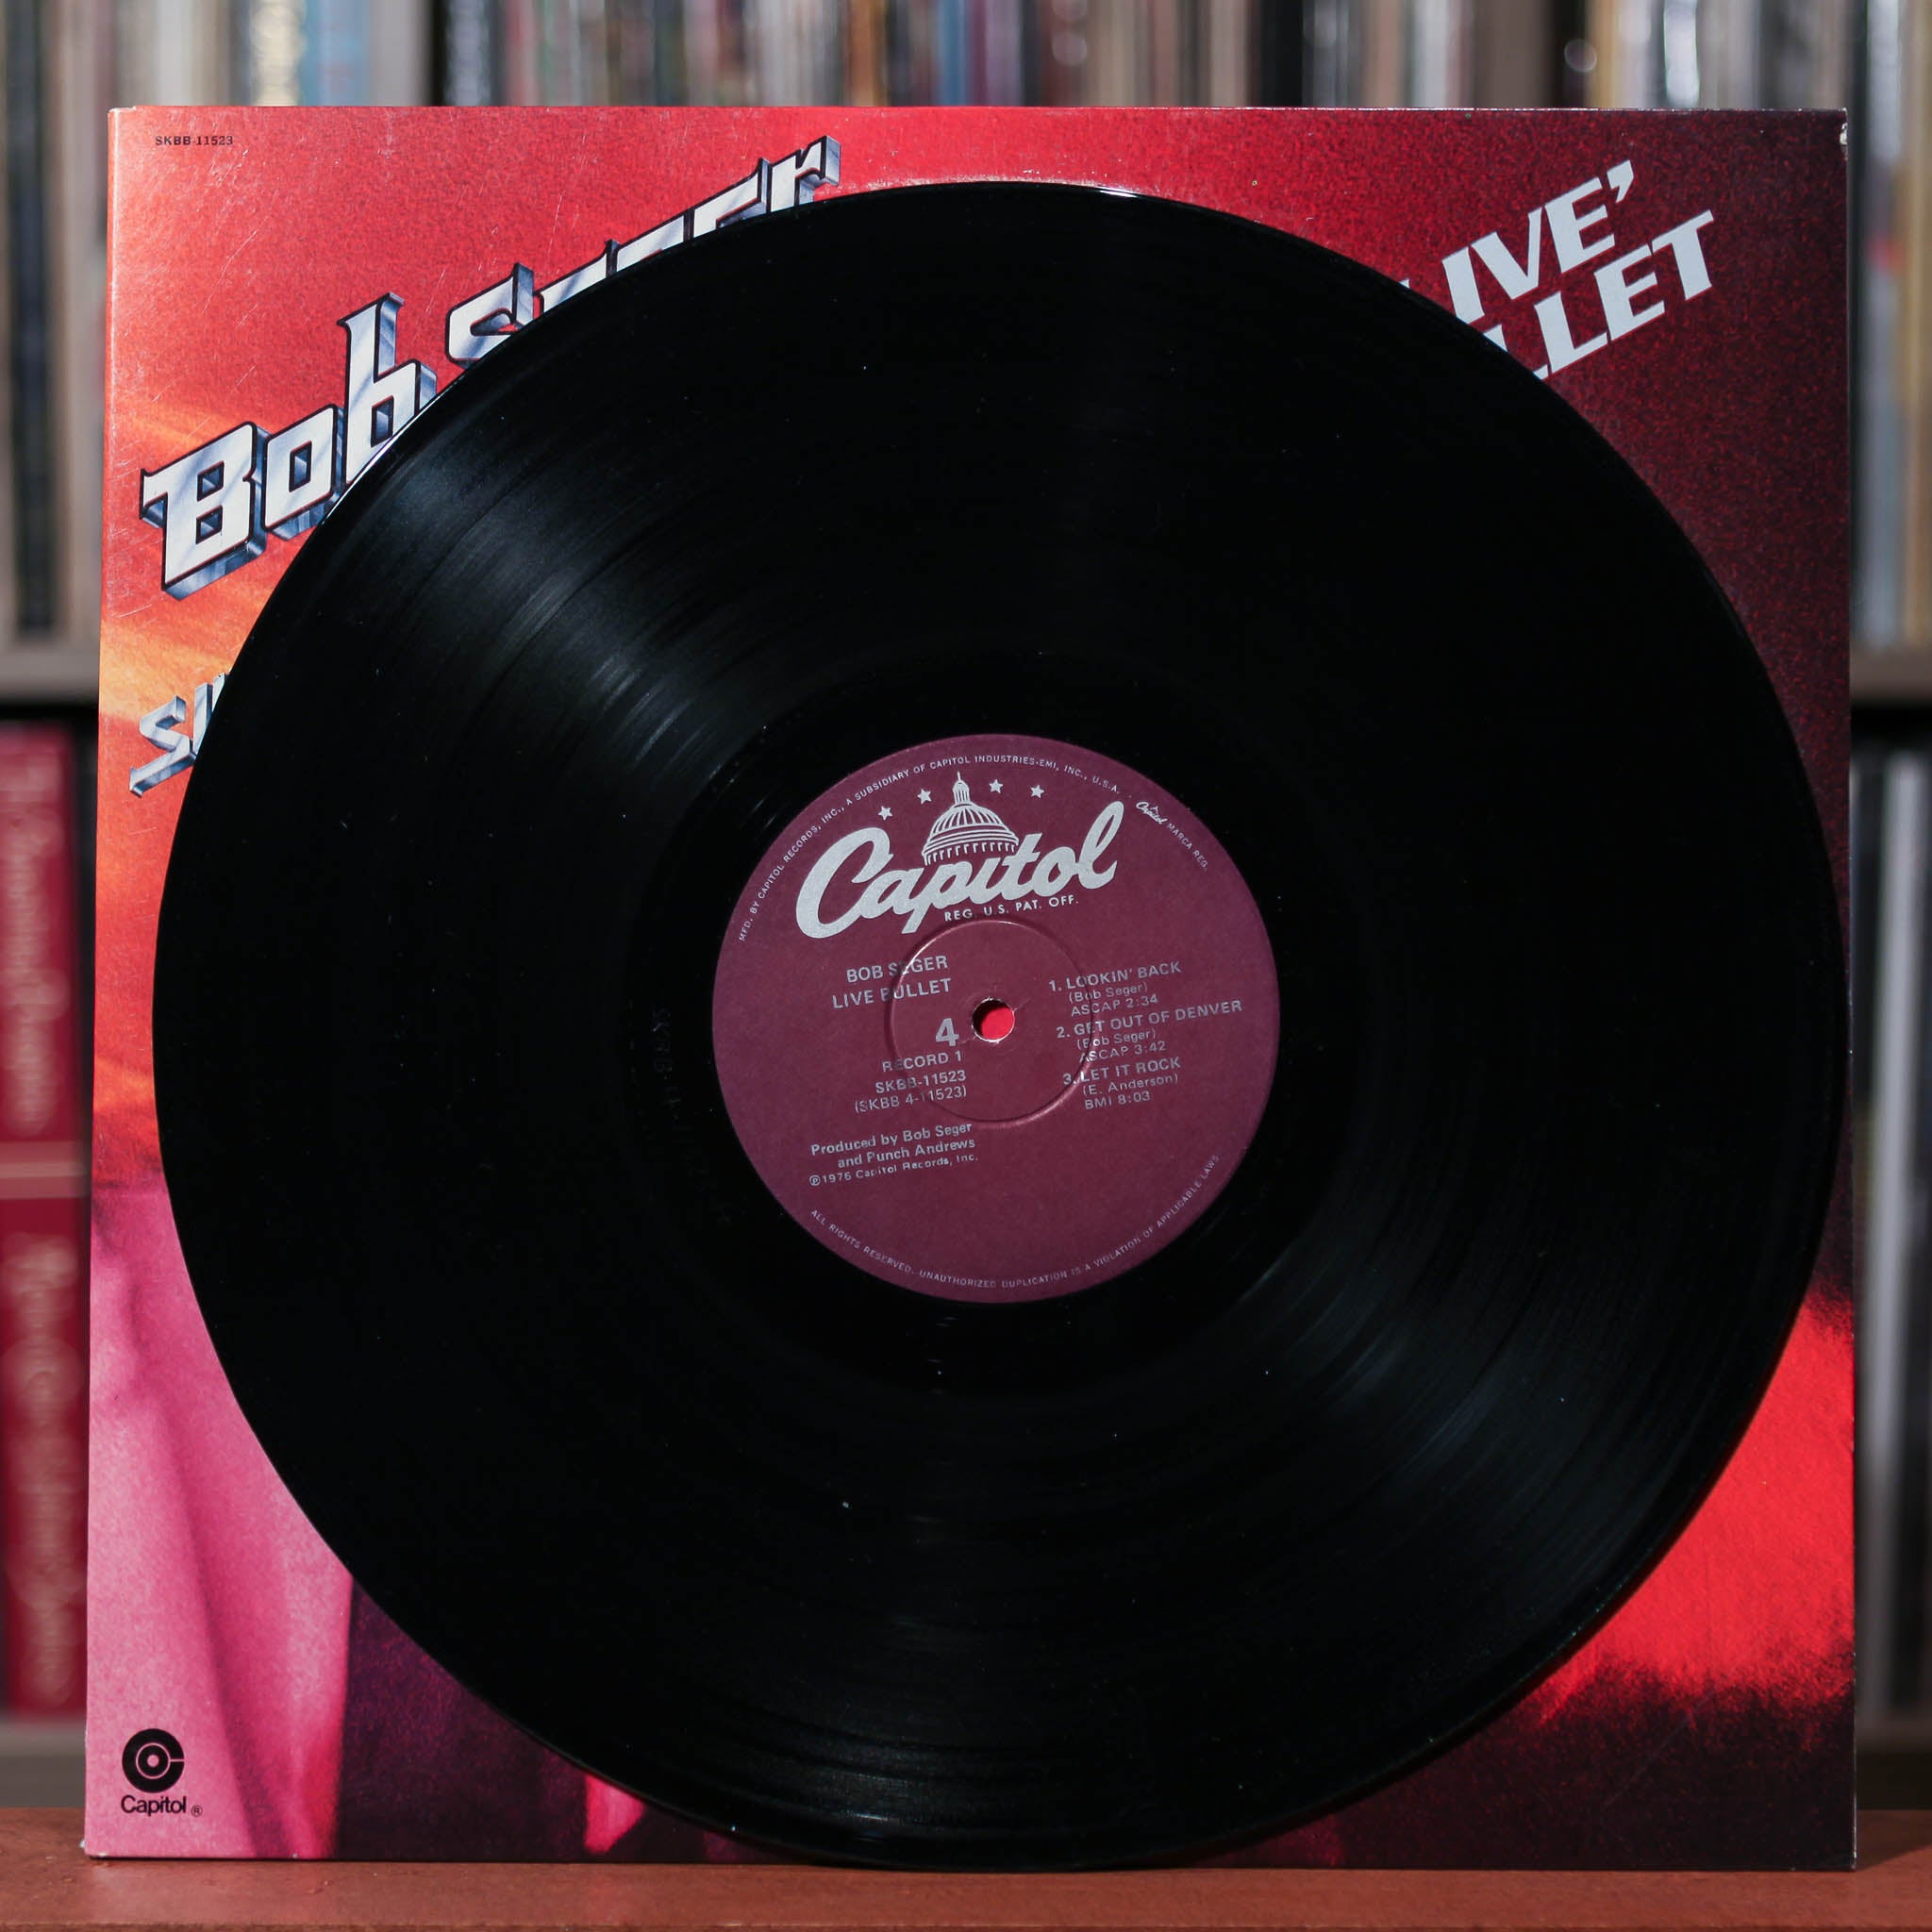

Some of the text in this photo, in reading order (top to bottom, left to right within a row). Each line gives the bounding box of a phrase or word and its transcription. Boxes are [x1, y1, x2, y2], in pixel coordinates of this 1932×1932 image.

[1400, 159, 1634, 325] IVE'
[1483, 209, 1714, 380] LET
[141, 293, 437, 600] Bob
[739, 919, 754, 941] MFD.
[749, 901, 760, 914] BY
[758, 864, 785, 899] CAPITOL
[782, 824, 822, 862] RECORDS,
[822, 806, 845, 824] INC.,
[855, 769, 910, 801] SUBSIDIARY
[913, 763, 925, 774] OF
[930, 757, 971, 770] CAPITOL
[1064, 765, 1088, 780] INC.,
[1092, 776, 1121, 794] U.S.A.
[1136, 802, 1208, 871] Capitol MARCA REG.
[796, 801, 1124, 939] Capitol
[983, 905, 1009, 917] U.S.
[1015, 900, 1042, 912] PAT.
[1048, 894, 1079, 908] OFF.
[846, 965, 883, 983] BOB
[1047, 960, 1182, 991] 1. LOOKIN' BACK
[832, 977, 952, 1009] LIVE BULLET
[1069, 981, 1149, 1004] (Bob Seger)
[1071, 993, 1158, 1017] ASCAP 2:34
[935, 1017, 960, 1047] 4
[1056, 1000, 1243, 1039] 2. GET OUT OF DENVER
[1076, 1028, 1157, 1051] (Bob Seger)
[1078, 1041, 1166, 1064] ASCAP 3:42
[882, 1050, 962, 1073] RECORD 1
[1062, 1056, 1182, 1087] 3. LET IT ROCK
[875, 1070, 966, 1093] SKBB-11523
[1083, 1073, 1179, 1097] (E. Anderson)
[855, 1085, 967, 1114] (SKBB 4-11523)
[1085, 1091, 1151, 1110] BMI 8:03
[810, 1124, 973, 1156] Produced by Bob Seger
[838, 1139, 975, 1169] and Punch Andrews
[856, 1164, 897, 1179] Capitol
[902, 1158, 953, 1172] Records,
[957, 1154, 979, 1163] Inc.
[810, 1155, 1220, 1289] ALL RIGHTS RESERVED. UNAUTHORIZED DUPLICATION IS A VIOLATION OF APPLICABLE LAWS
[121, 1795, 187, 1817] Capitol
